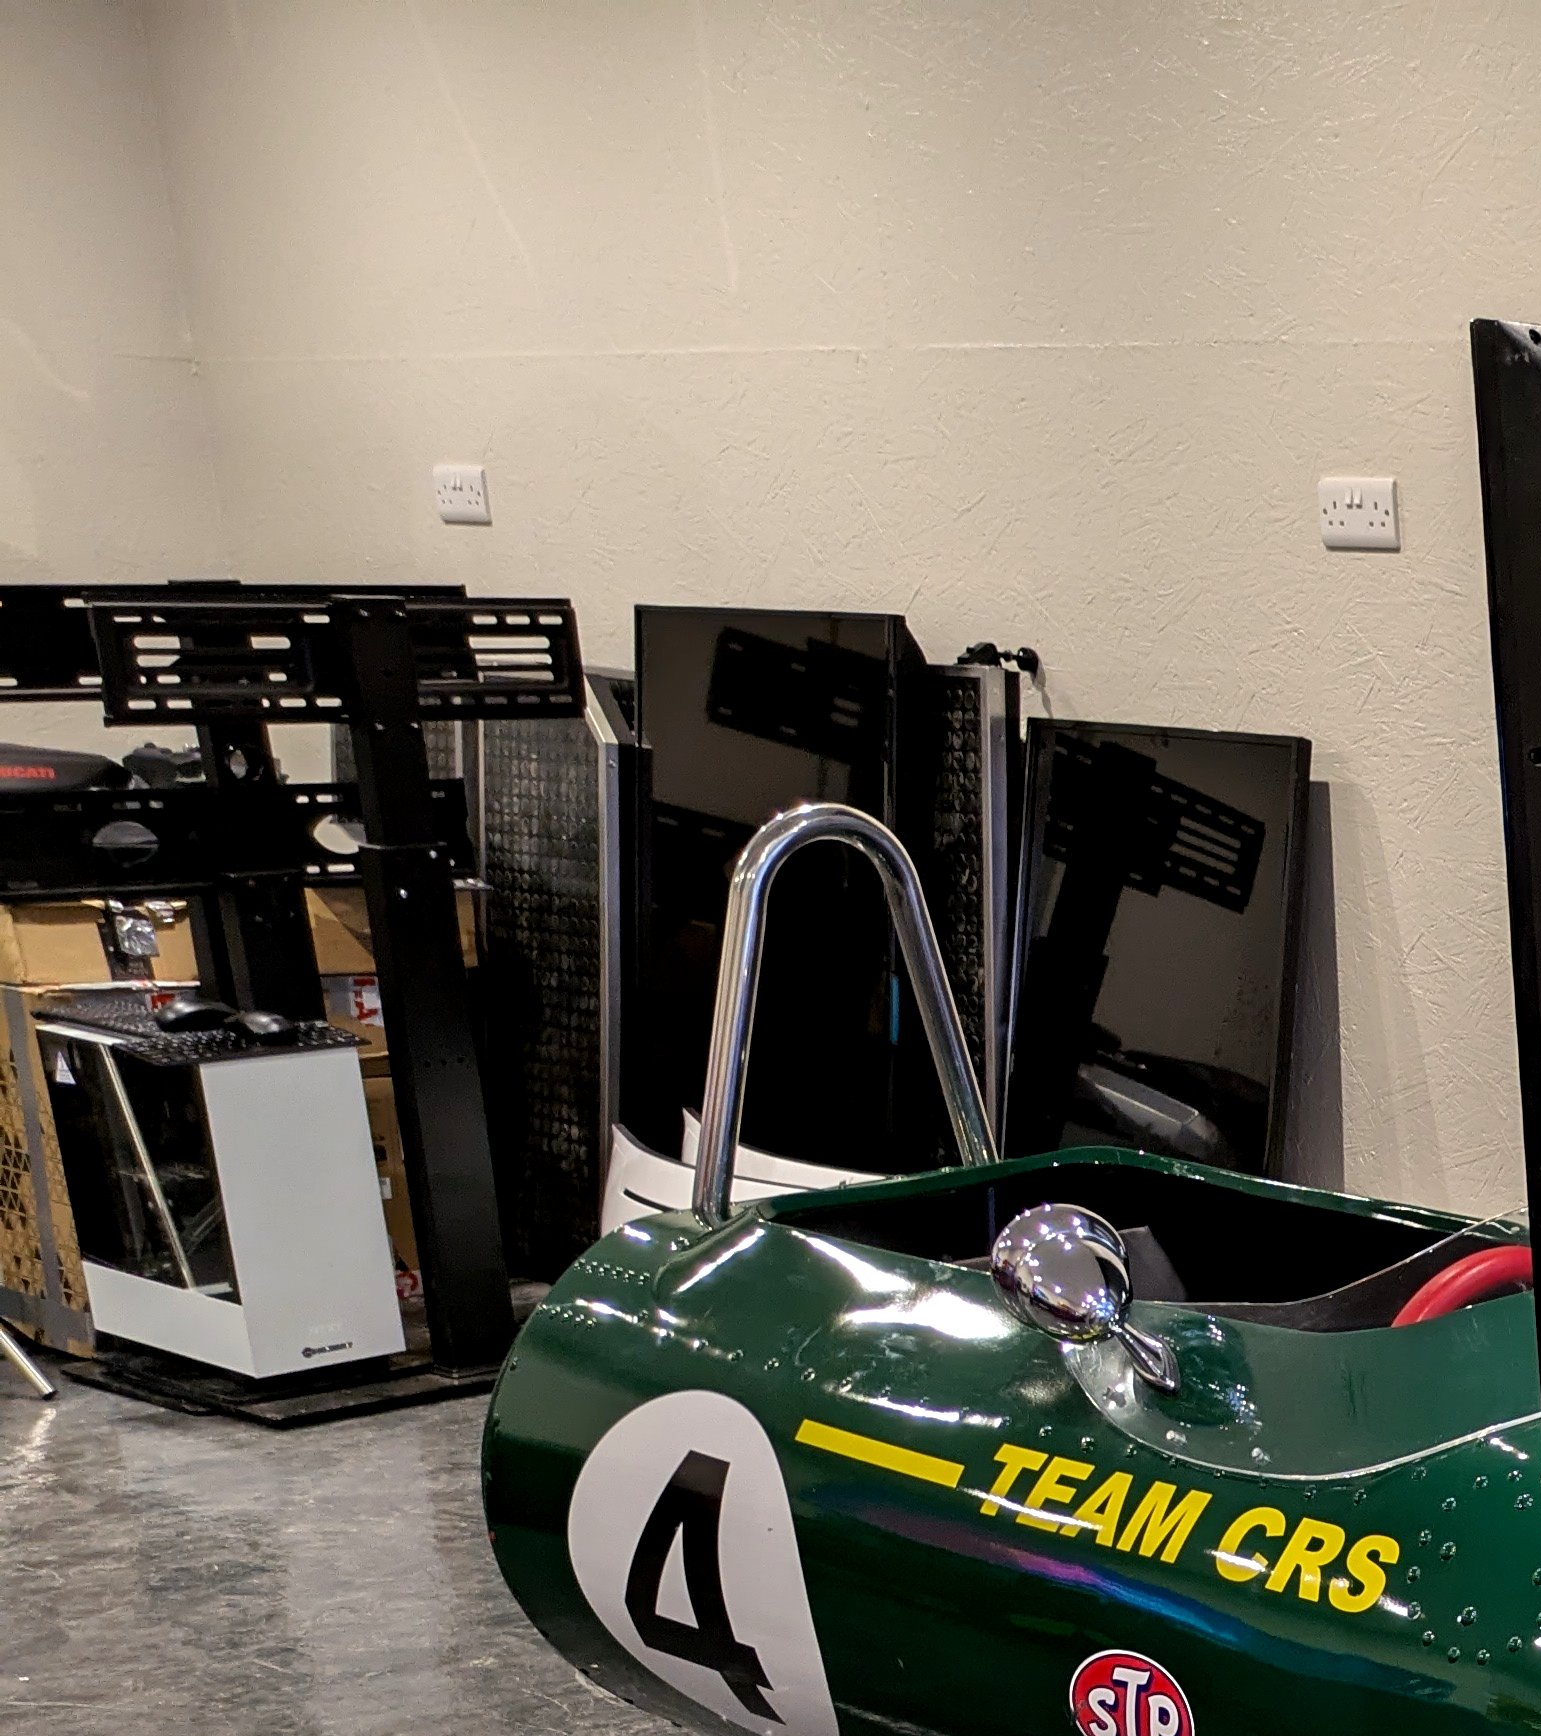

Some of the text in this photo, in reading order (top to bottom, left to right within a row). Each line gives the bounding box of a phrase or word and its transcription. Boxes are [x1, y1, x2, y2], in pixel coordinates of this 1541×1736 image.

[625, 1450, 787, 1726] 4
[979, 1443, 1400, 1613] TEAM CRS
